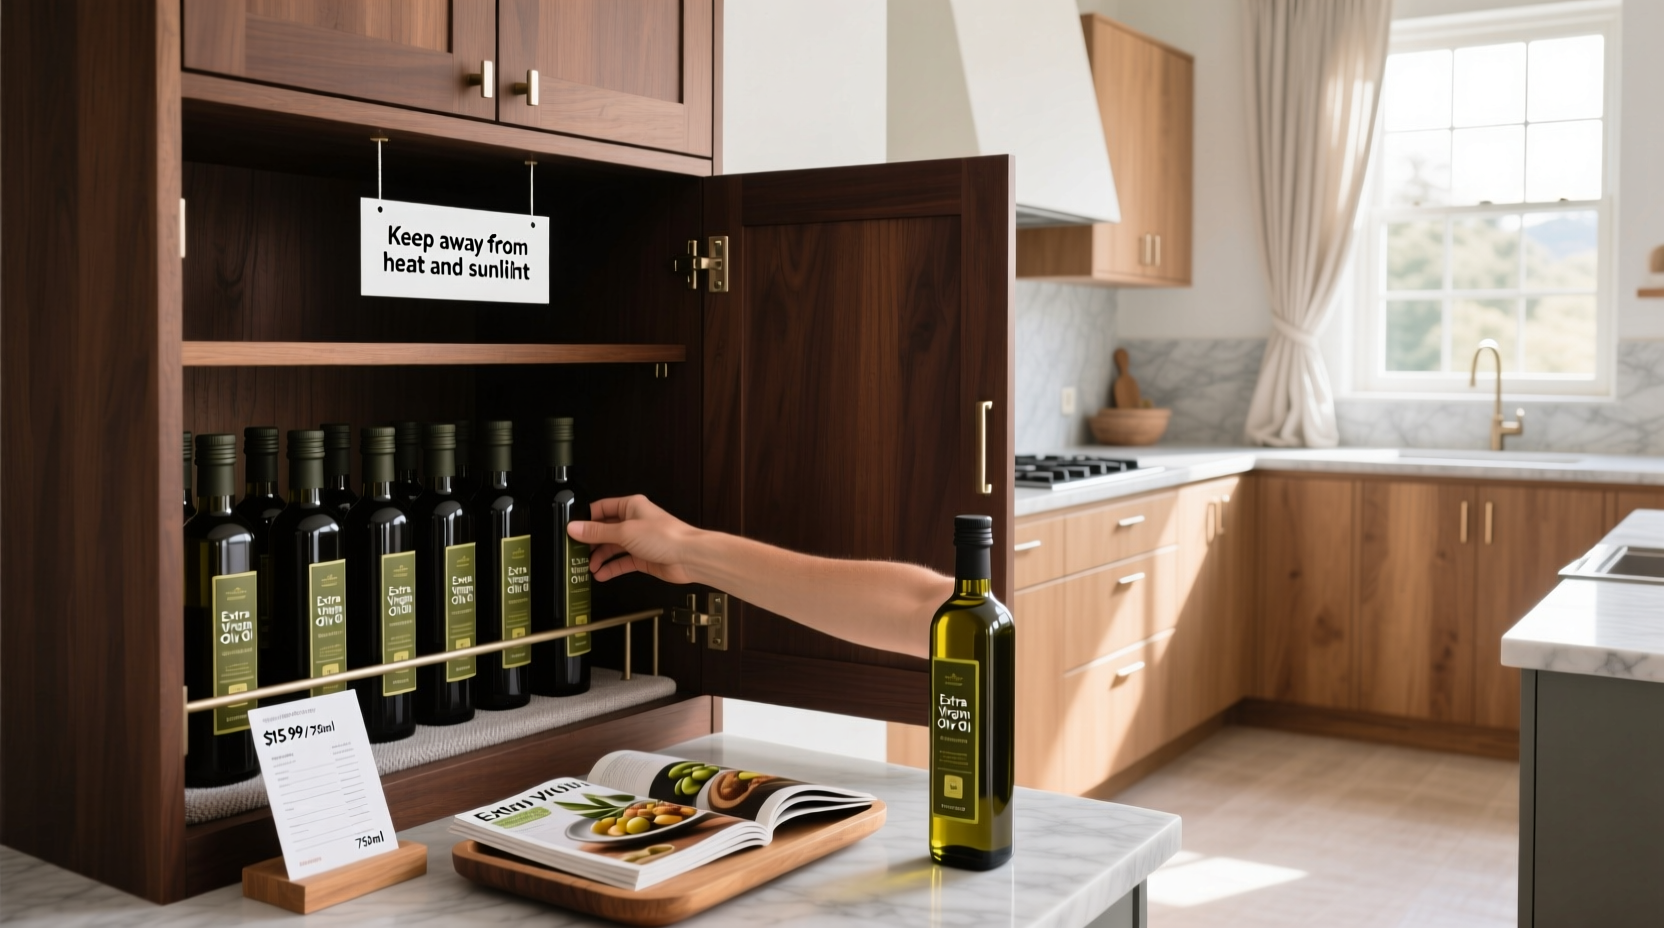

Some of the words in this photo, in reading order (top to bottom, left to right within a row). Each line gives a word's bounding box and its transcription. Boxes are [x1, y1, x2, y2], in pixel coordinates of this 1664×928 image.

[388, 225, 434, 253] Keep
[440, 235, 483, 257] away
[487, 233, 528, 255] from
[383, 251, 425, 274] heat
[430, 257, 463, 276] and
